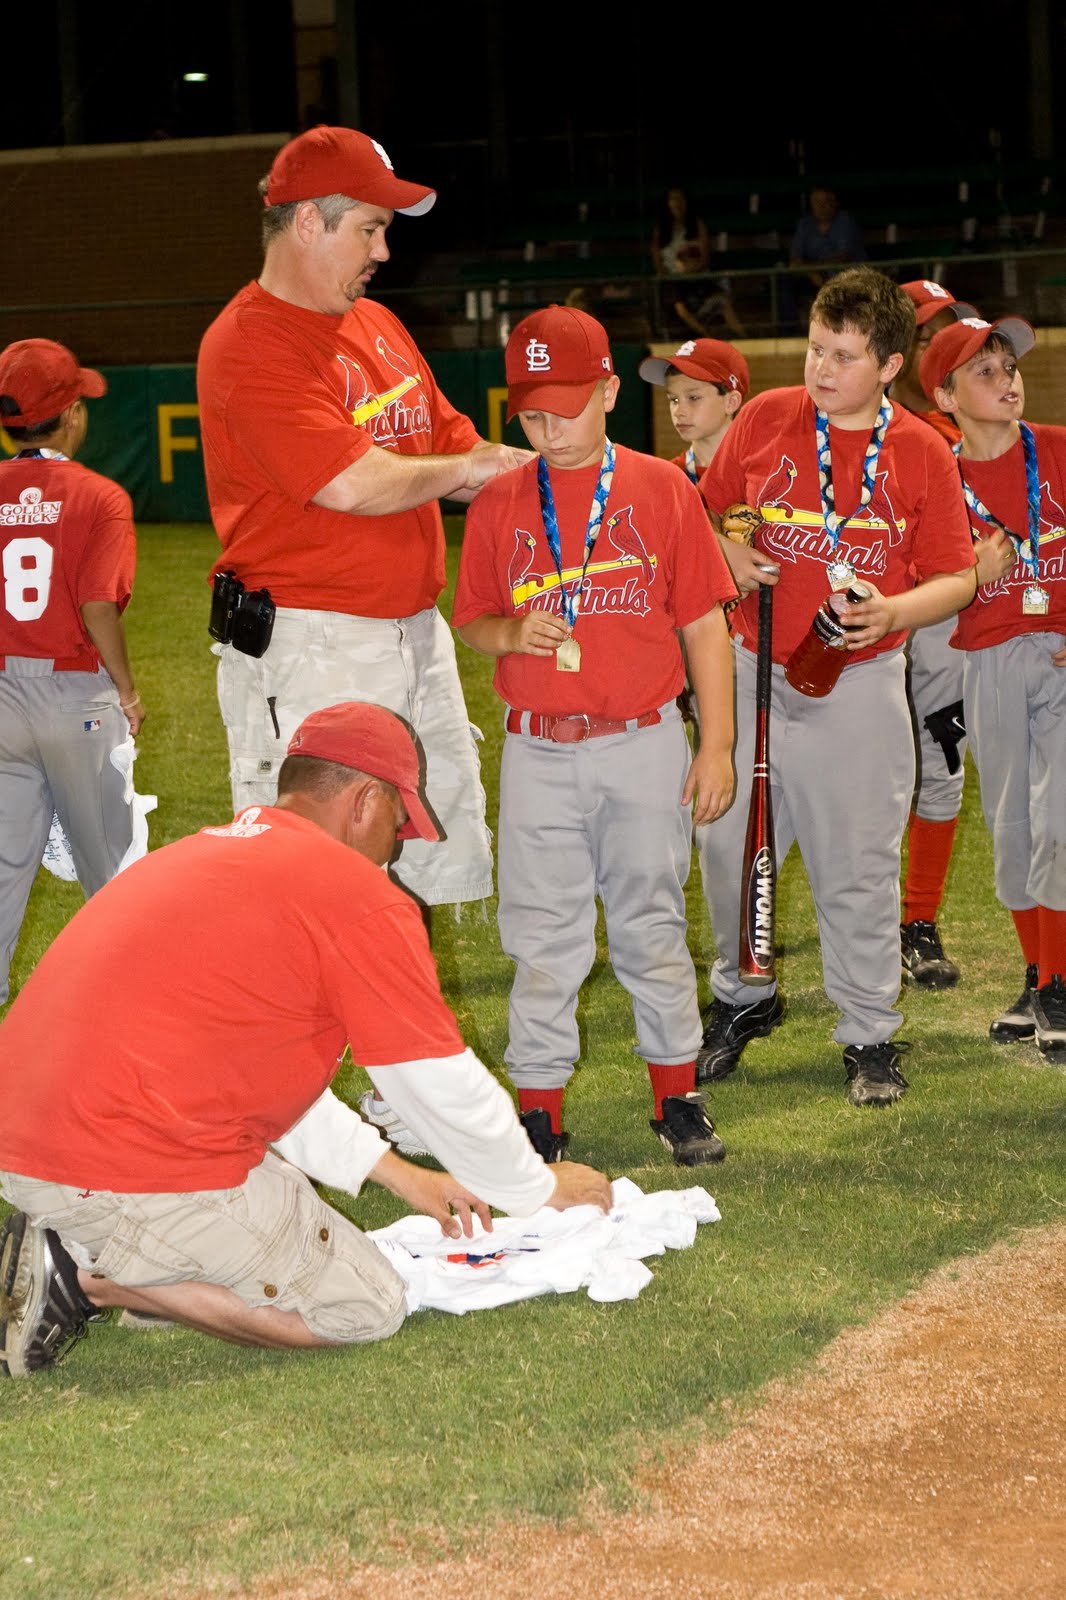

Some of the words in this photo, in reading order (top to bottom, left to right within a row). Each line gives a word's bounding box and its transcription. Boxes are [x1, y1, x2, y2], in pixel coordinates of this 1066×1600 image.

[362, 394, 432, 448] ainals
[0, 502, 61, 517] GOLDEN
[5, 512, 52, 525] CHICK
[2, 536, 54, 622] 8
[514, 577, 652, 618] arinals
[754, 877, 774, 957] WORTH
